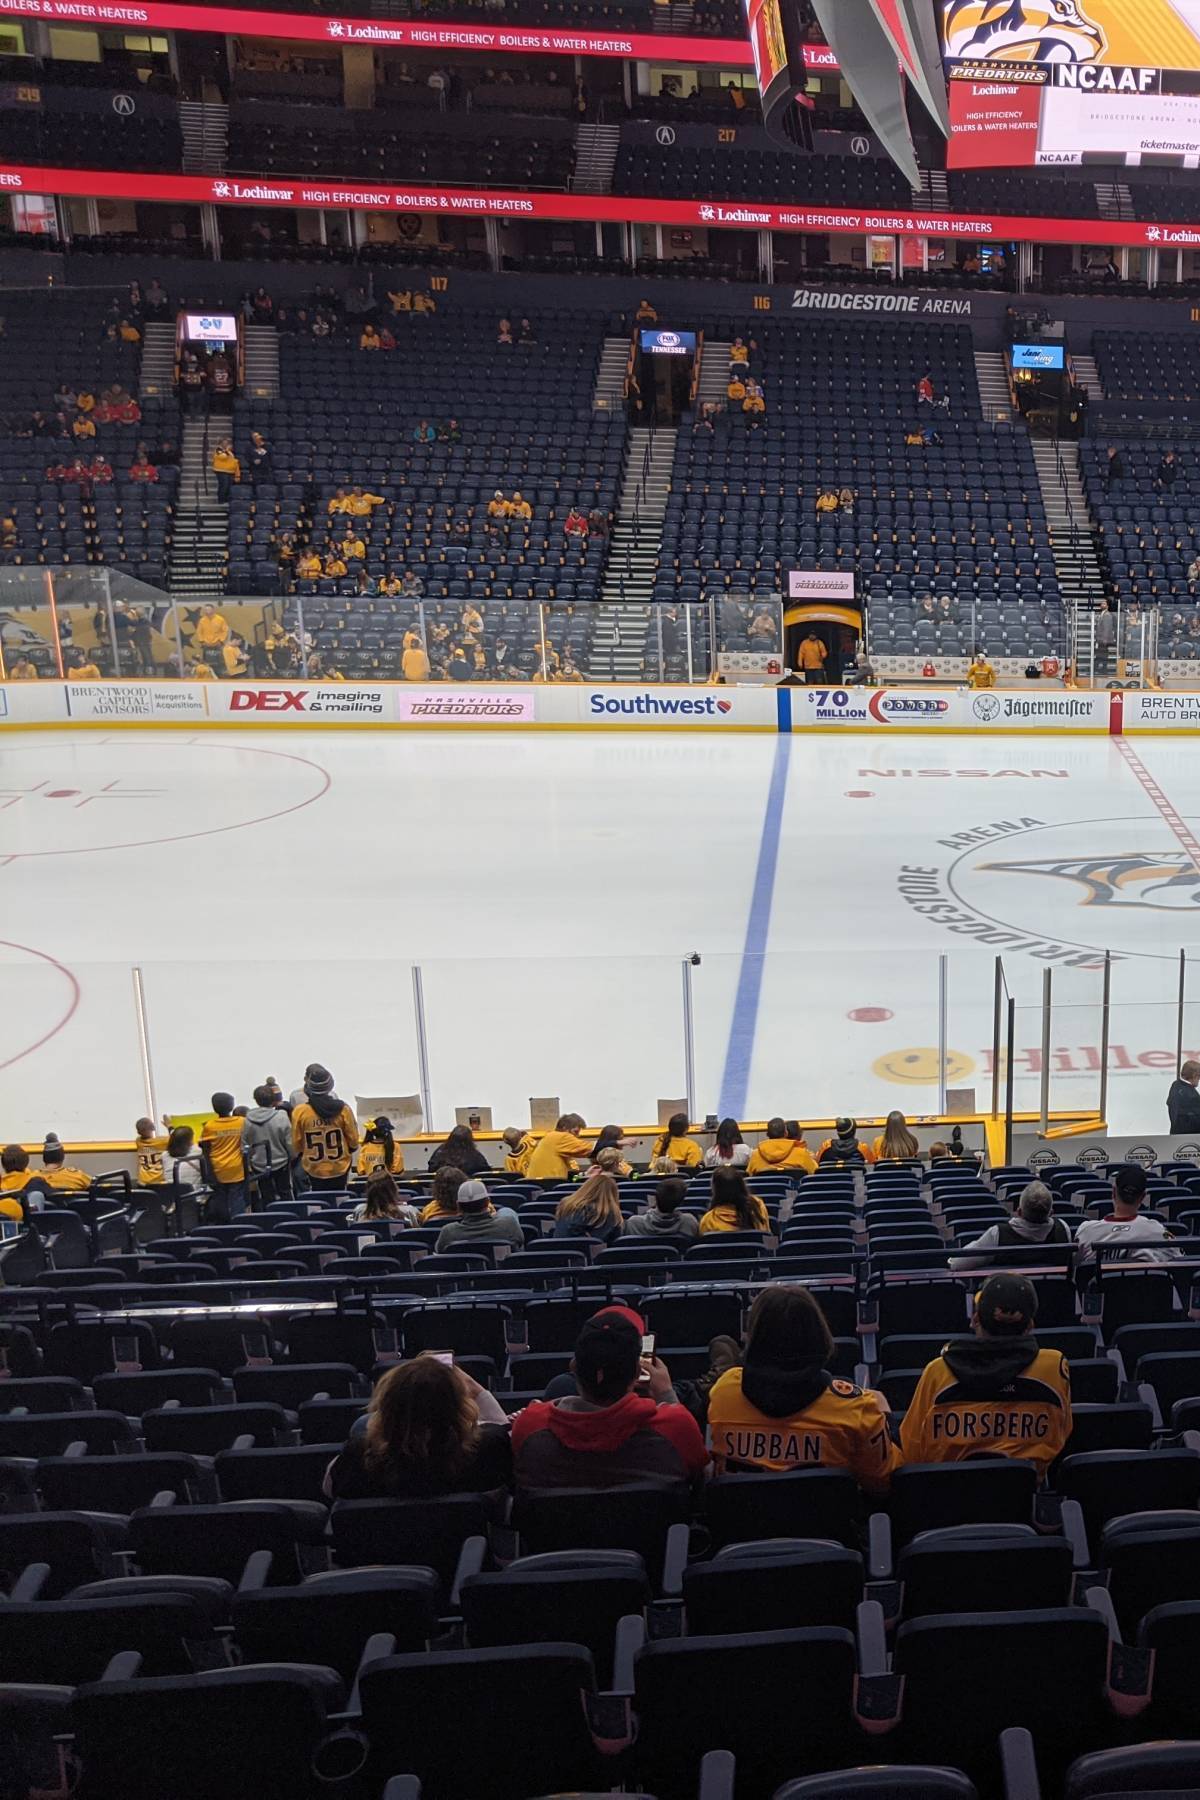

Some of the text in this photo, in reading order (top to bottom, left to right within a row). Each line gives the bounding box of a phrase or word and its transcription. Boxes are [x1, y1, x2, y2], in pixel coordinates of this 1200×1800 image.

[0, 0, 148, 21] OILERS & WATER HEATERS
[347, 25, 632, 52] Lochinvar HIGH EFFICIENCY BOILERS & WATER HEATERS
[950, 66, 1047, 82] PREDATORS
[1058, 64, 1156, 91] NCAAF
[972, 85, 1019, 97] Lochinvar
[966, 111, 1023, 120] HIGH EFFICIENCY
[977, 123, 983, 131] &
[984, 122, 1008, 131] WATER
[1008, 121, 1038, 130] HEATERS
[717, 129, 737, 143] 217
[1140, 139, 1200, 151] ticketmaster
[1039, 153, 1079, 163] NCAAF
[233, 185, 533, 211] Lochinvar HIGH EFFICIENCY BOILERS & WATER HEATERS
[718, 208, 993, 233] Lochinvar HIGH EFFICIENCY BOILERS & WATER HEATERS
[431, 277, 448, 291] 117
[754, 296, 770, 310] 116
[792, 290, 972, 314] BRIDGESTONE ARENA
[652, 346, 686, 354] TENNESSEE
[72, 687, 147, 696] BRENTWOOD
[316, 691, 382, 703] imaging
[808, 690, 849, 707] $70
[98, 696, 149, 705] CAPITAL
[229, 690, 311, 712] DEX
[591, 694, 716, 716] Southwest
[92, 704, 150, 714] ADVISORS
[309, 702, 383, 714] & mailing
[410, 703, 525, 716] PREDATORS
[816, 709, 867, 718] MILLION
[1141, 711, 1178, 721] AUTO
[858, 769, 1069, 778] NISSAN
[936, 817, 1047, 850] ARENA
[898, 865, 1130, 970] BRIDGESTONE
[305, 1128, 342, 1162] 59
[932, 1413, 1049, 1440] FORSBERG
[725, 1432, 821, 1460] SUBBAN
